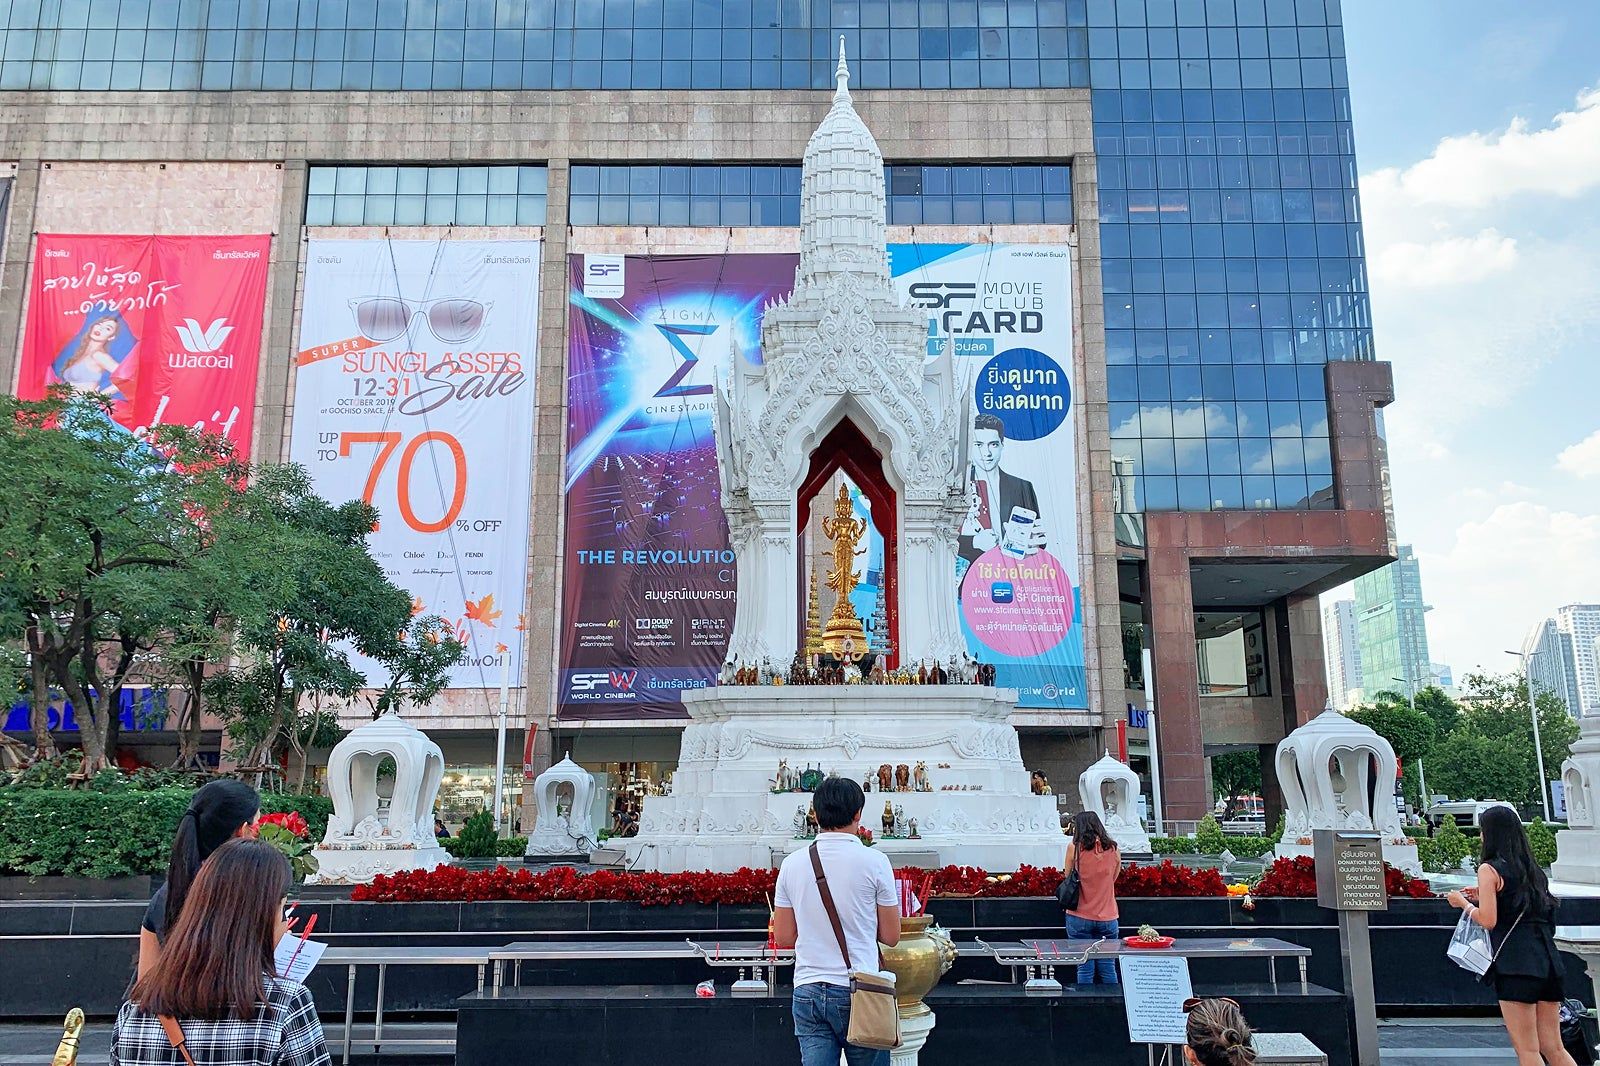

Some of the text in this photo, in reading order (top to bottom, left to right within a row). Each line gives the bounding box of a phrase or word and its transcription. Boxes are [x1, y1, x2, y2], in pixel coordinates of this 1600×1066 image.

[43, 262, 142, 292] สวยให้สุด
[590, 264, 619, 276] SF
[909, 282, 1042, 308] SF MOVIE
[984, 297, 1043, 309] CLUB
[942, 311, 1043, 333] CARD
[311, 340, 359, 358] SUPER
[168, 353, 233, 369] Wacoal
[343, 352, 522, 374] SUNGLASSES
[989, 363, 1057, 390] ยิ่งดูมาก
[353, 378, 410, 396] 12-31
[399, 358, 526, 415] Sale
[984, 388, 1062, 410] ยิ่งลดมาก
[319, 433, 339, 444] UP
[317, 450, 338, 461] TO
[339, 431, 468, 534] 70
[474, 520, 502, 532] OFF
[577, 550, 735, 565] THE REVOLUTIO
[978, 563, 1056, 579] ใช้ง่ายโดนใจ
[645, 588, 736, 603] สมบูรณ์แบบครบทุ
[1017, 593, 1065, 603] SF Cinema
[974, 607, 1063, 616] www.sfcinemacity.com
[607, 620, 621, 628] 4K
[647, 676, 707, 689] เซ็นทรัลเวิลด์
